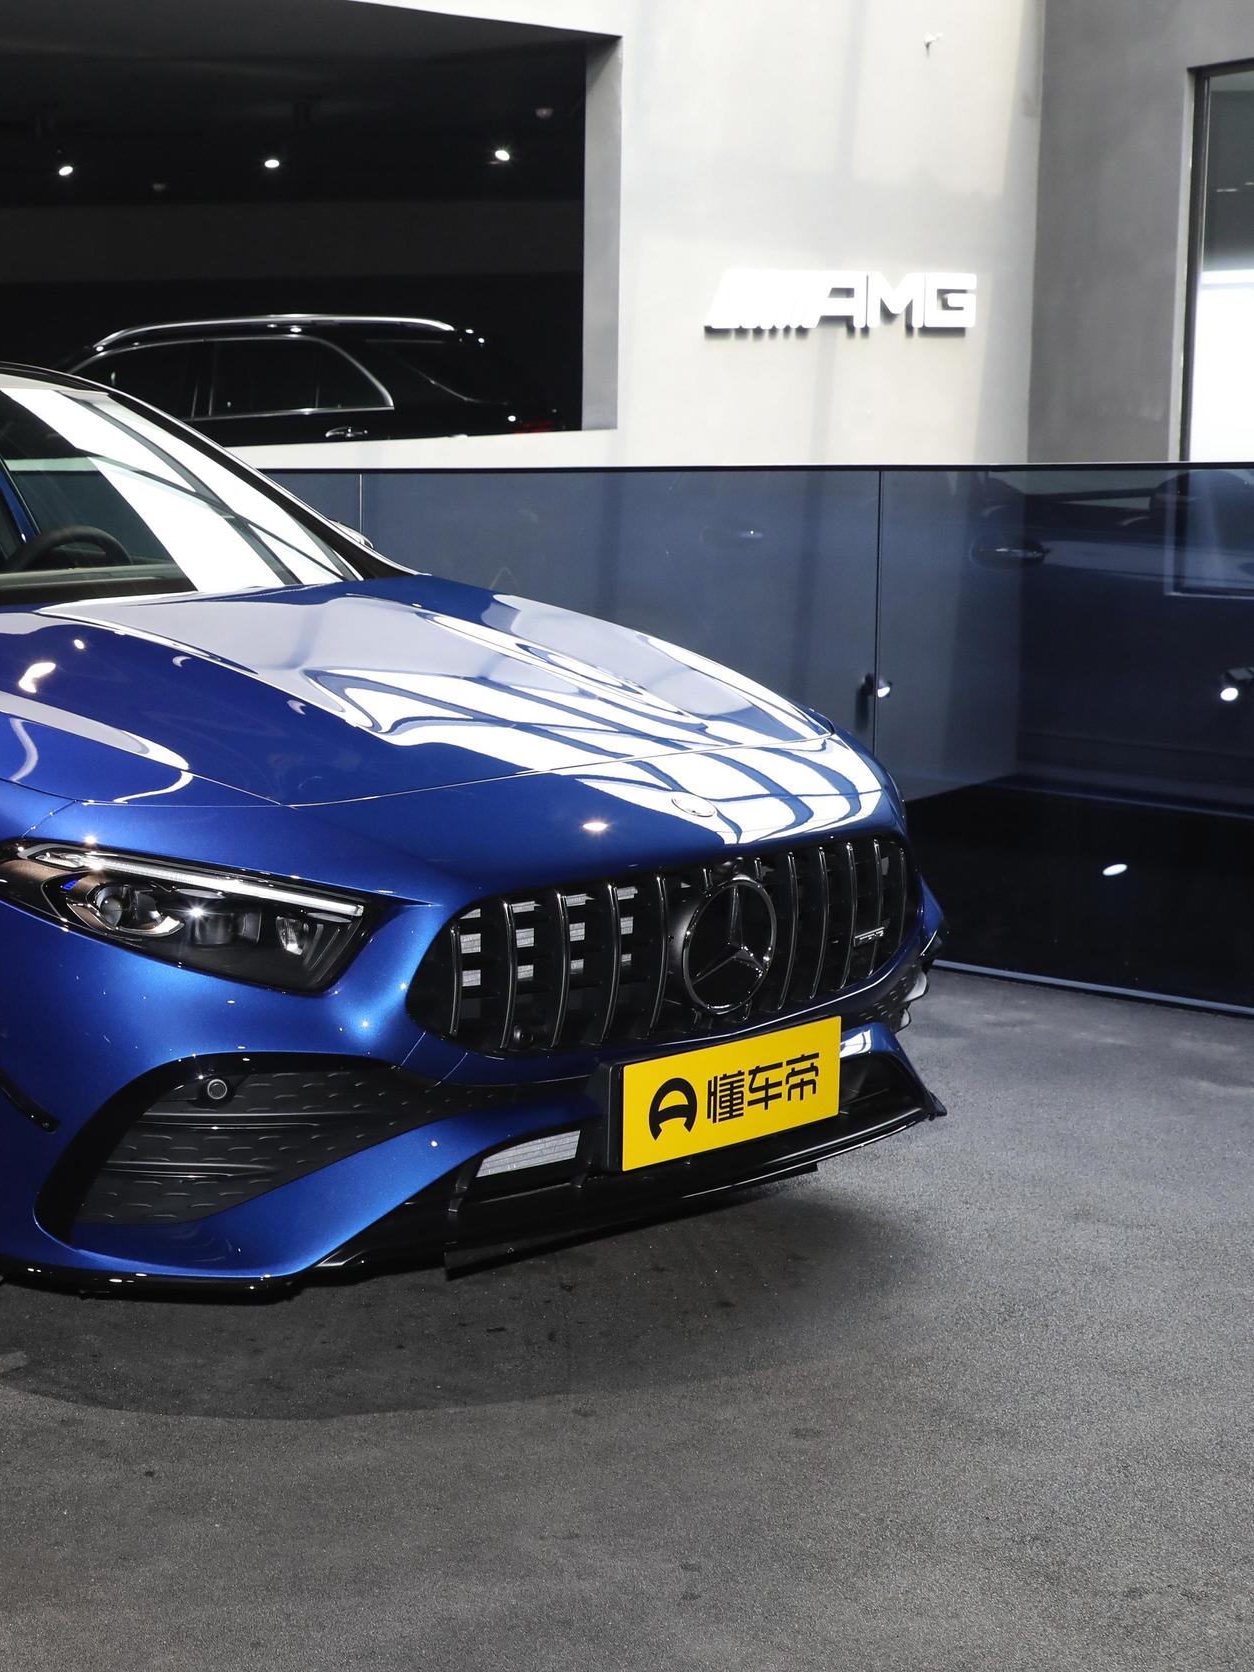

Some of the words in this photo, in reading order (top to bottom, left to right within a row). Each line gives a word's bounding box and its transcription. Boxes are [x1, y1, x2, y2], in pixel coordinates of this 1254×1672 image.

[802, 269, 978, 330] AMG
[706, 1052, 820, 1124] 懂车帝
